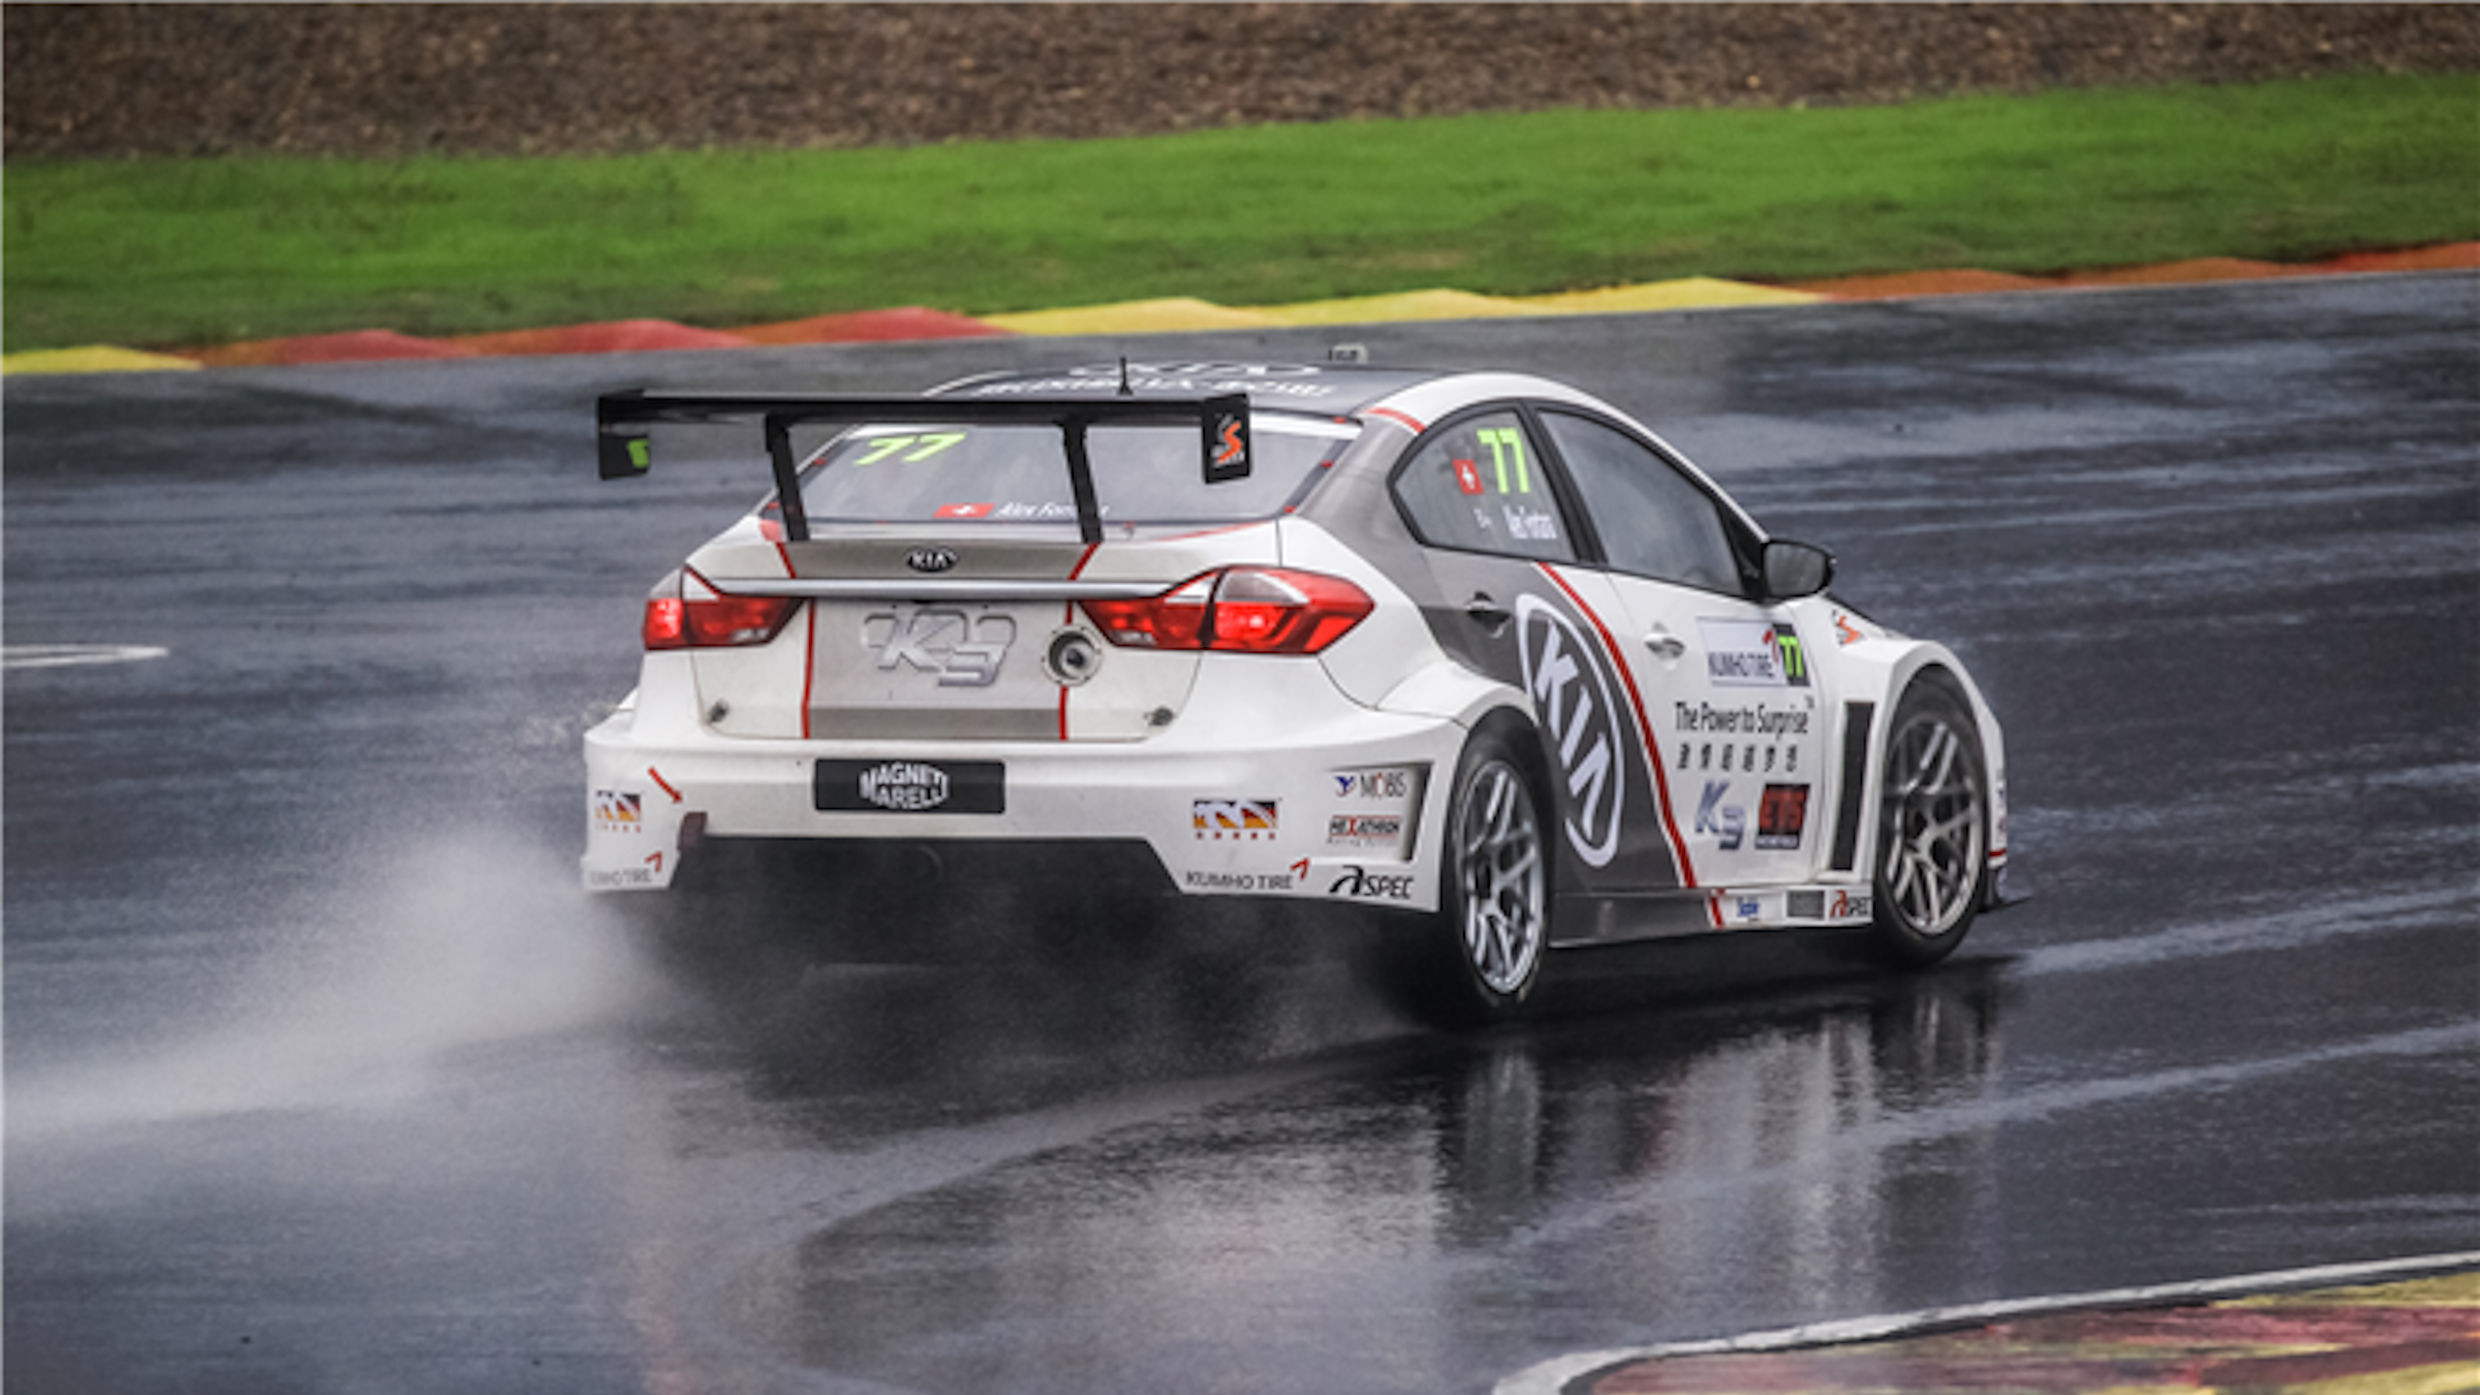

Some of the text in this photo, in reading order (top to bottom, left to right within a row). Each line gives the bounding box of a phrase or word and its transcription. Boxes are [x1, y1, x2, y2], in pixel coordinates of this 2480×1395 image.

[853, 432, 967, 466] 77
[1476, 428, 1529, 494] 77
[911, 551, 952, 569] KIA
[1776, 635, 1805, 677] 77
[1534, 617, 1611, 841] KIA
[1676, 701, 1809, 741] The Power to Surprise
[1186, 872, 1293, 889] KUMHO TIRE
